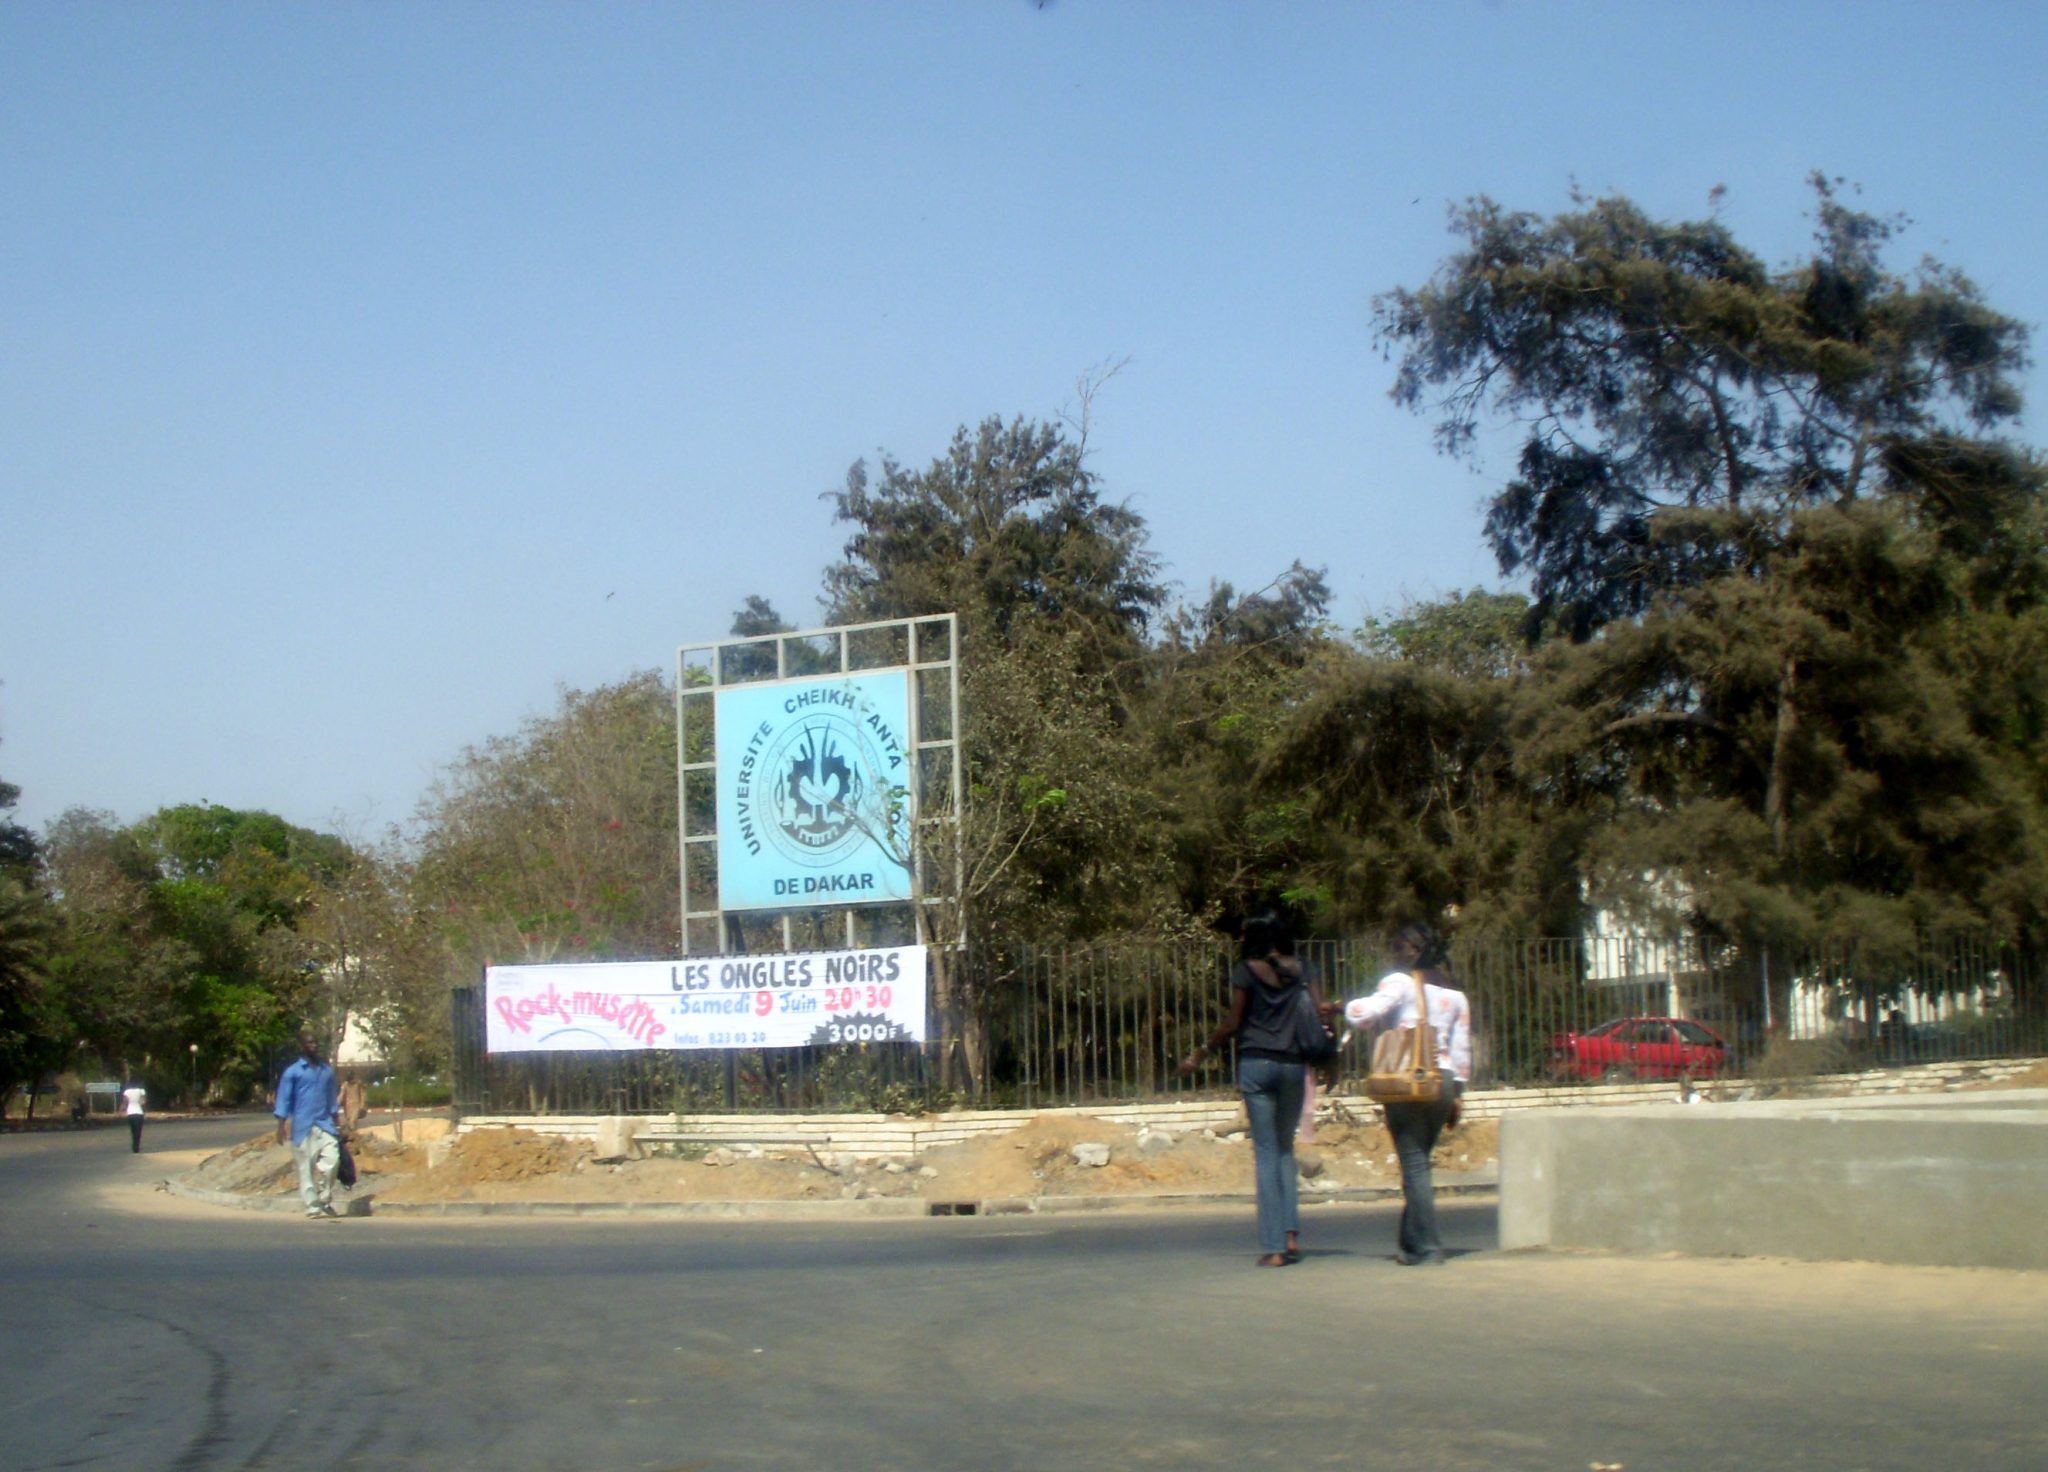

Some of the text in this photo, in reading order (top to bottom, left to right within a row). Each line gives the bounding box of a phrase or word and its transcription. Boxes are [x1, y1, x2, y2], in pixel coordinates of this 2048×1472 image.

[736, 720, 774, 857] UNIVERSITE
[784, 688, 856, 715] CHEIKH
[866, 712, 903, 770] ANTA
[774, 872, 875, 896] DE DAKAR
[671, 963, 709, 991] LES
[721, 959, 812, 989] ONGLES
[754, 990, 773, 1016] 9
[779, 992, 816, 1013] Juin
